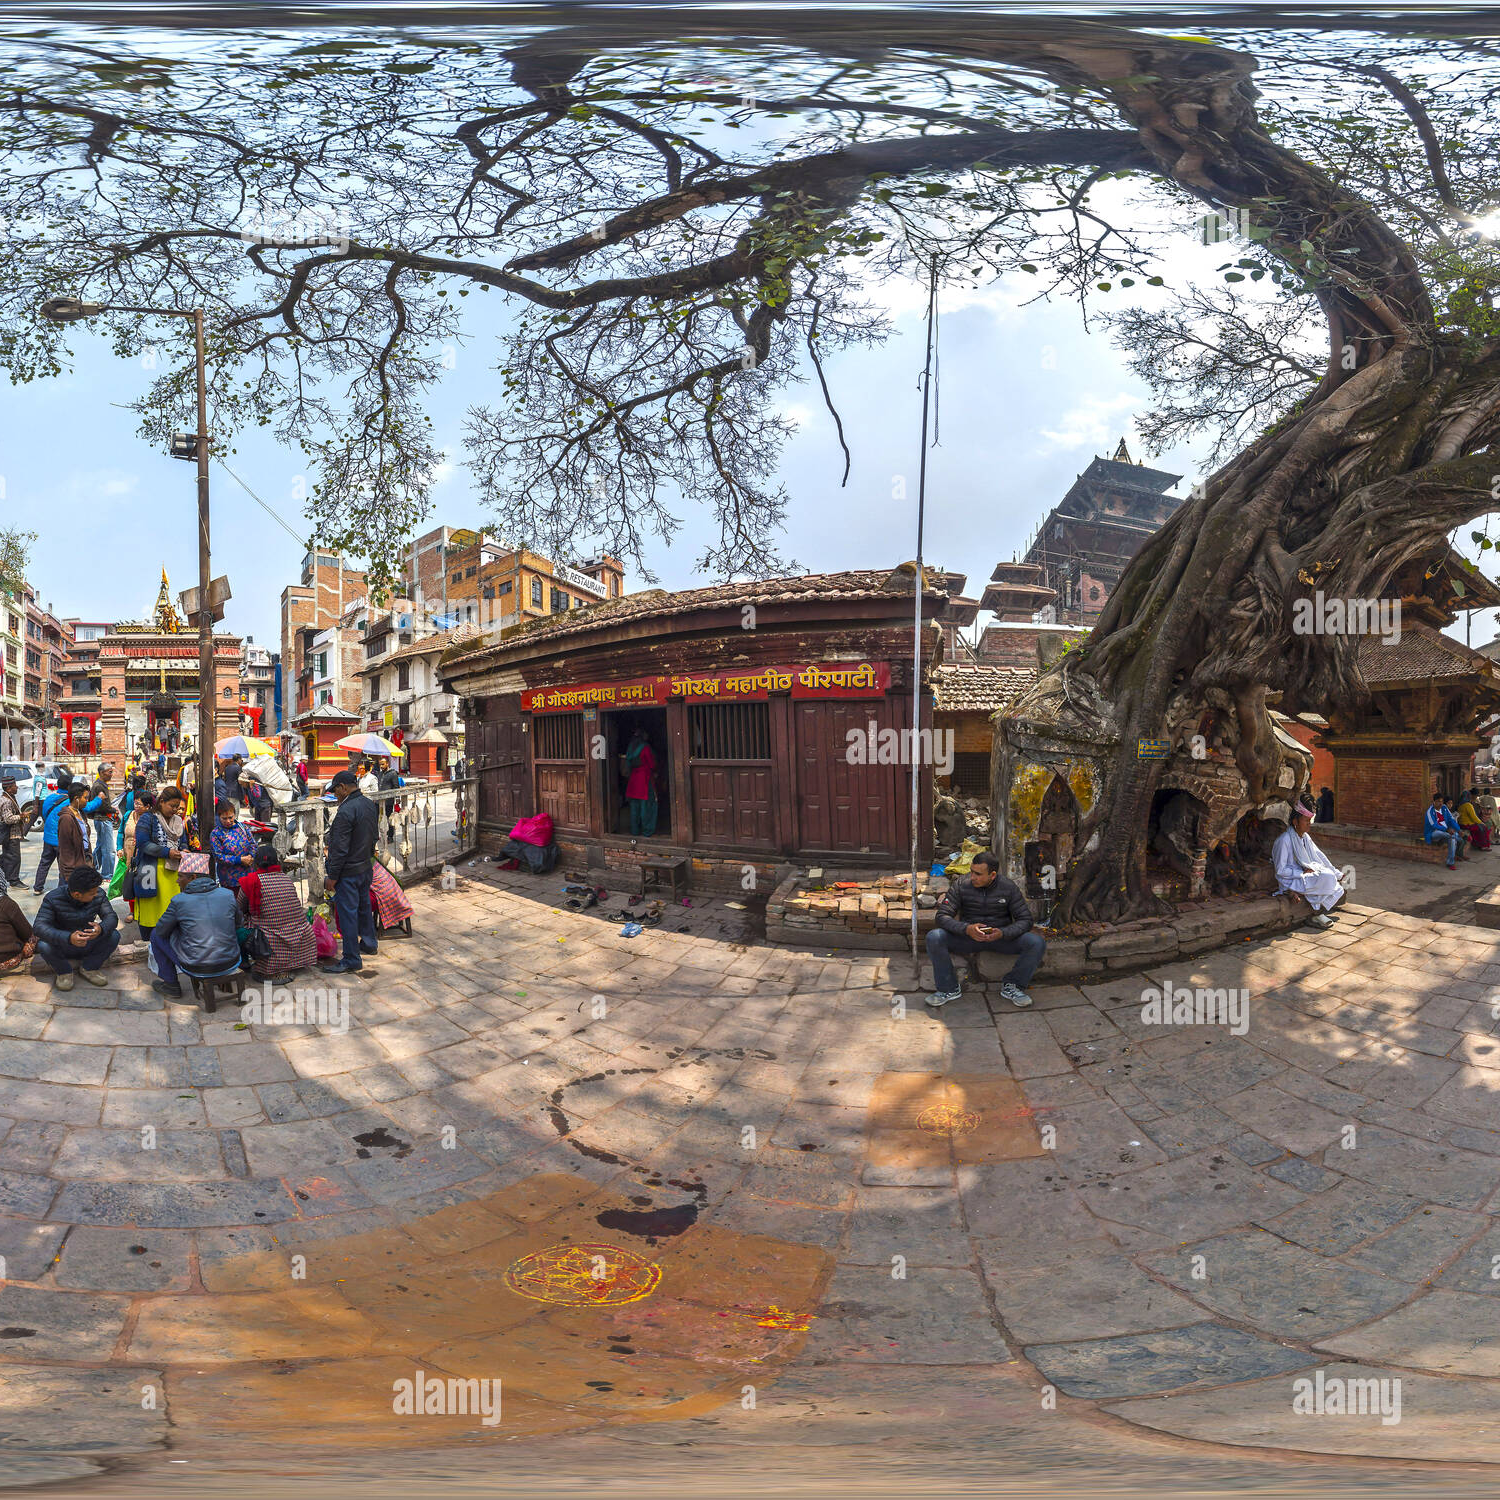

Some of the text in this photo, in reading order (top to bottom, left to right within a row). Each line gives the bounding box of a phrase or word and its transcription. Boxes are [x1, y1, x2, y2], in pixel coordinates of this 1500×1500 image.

[569, 572, 606, 595] RESTAURANT
[671, 663, 875, 696] गोरक्ष महापीठ पीरपाटी
[532, 693, 545, 709] श्री
